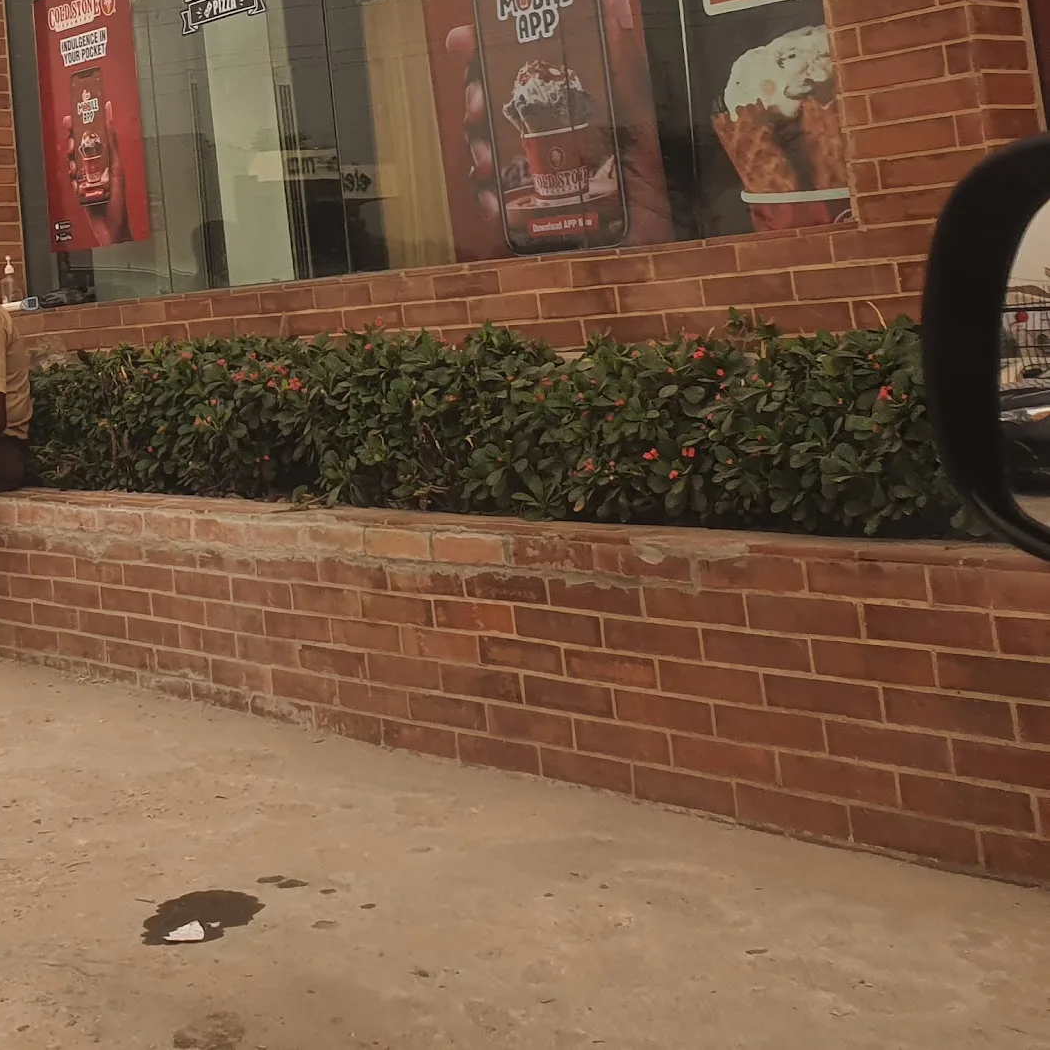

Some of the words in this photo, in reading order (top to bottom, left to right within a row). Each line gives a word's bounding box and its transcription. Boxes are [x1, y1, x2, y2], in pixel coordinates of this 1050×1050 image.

[518, 9, 556, 39] APP
[62, 32, 98, 52] INDULGENCE
[100, 29, 106, 41] IN
[63, 51, 80, 64] YOUR
[81, 43, 105, 60] POCKET
